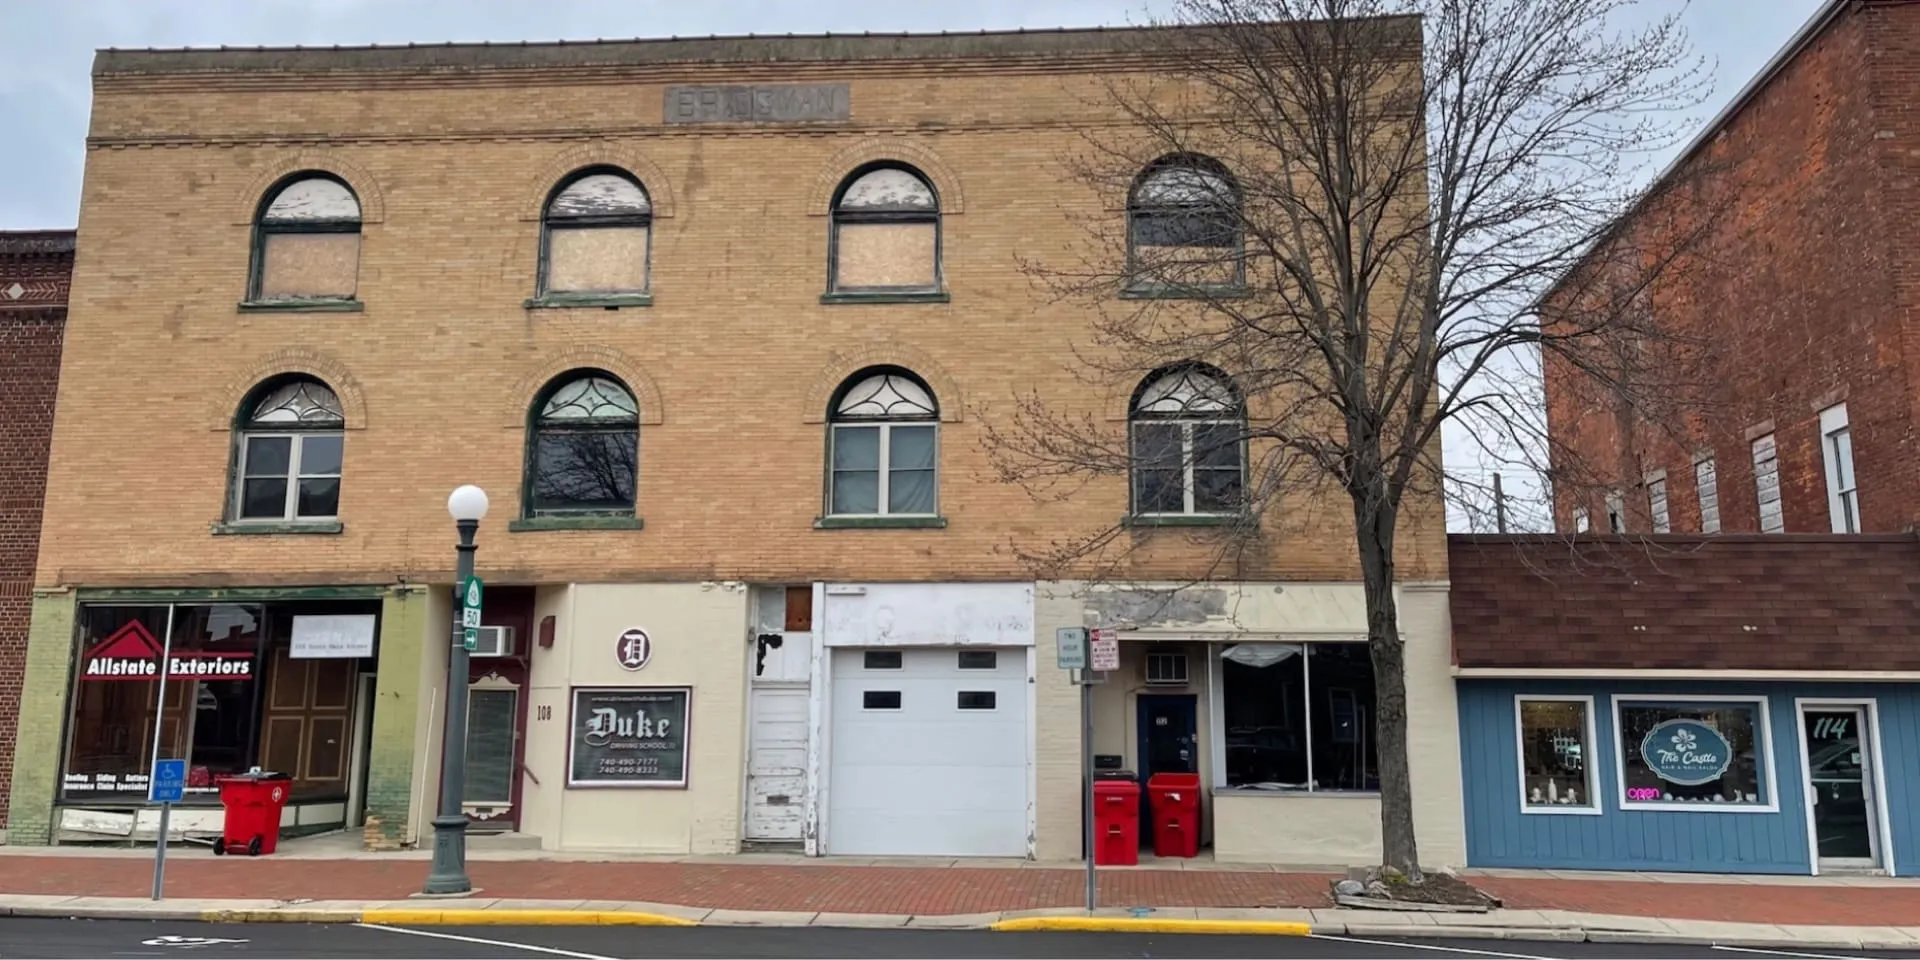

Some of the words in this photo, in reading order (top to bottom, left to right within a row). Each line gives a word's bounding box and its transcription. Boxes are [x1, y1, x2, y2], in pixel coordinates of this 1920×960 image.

[467, 610, 478, 625] 50
[624, 633, 646, 665] D
[86, 657, 156, 675] Allstate
[169, 656, 250, 675] Exteriors
[537, 704, 552, 721] 108
[584, 707, 671, 744] Duke
[1813, 717, 1849, 740] 114
[639, 742, 668, 750] SCHOOL
[599, 758, 659, 766] 740-490-7171
[1657, 749, 1679, 764] The
[1682, 751, 1717, 765] Castle
